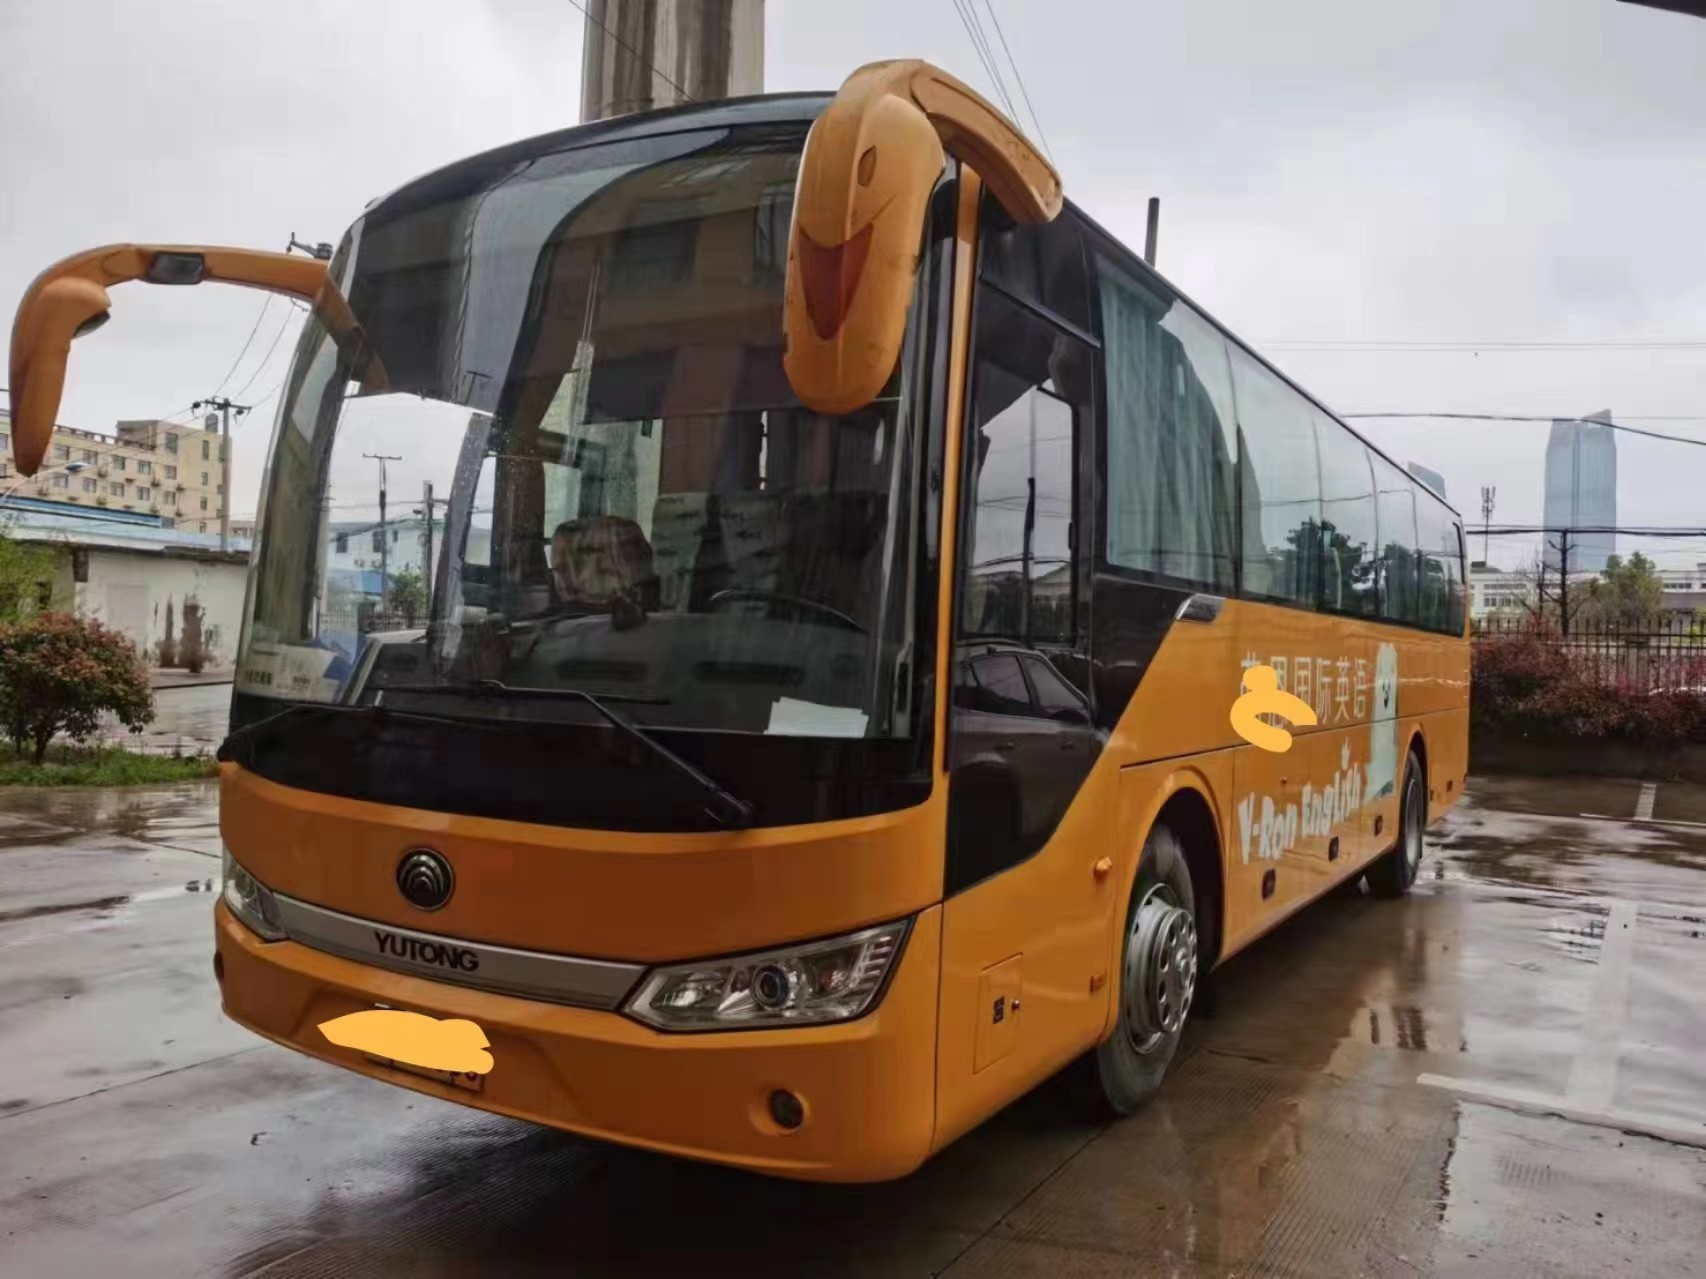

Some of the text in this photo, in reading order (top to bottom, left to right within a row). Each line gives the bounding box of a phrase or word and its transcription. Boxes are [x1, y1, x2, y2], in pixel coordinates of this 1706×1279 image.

[1240, 648, 1368, 728] 国际英语
[374, 930, 480, 972] YUTONG
